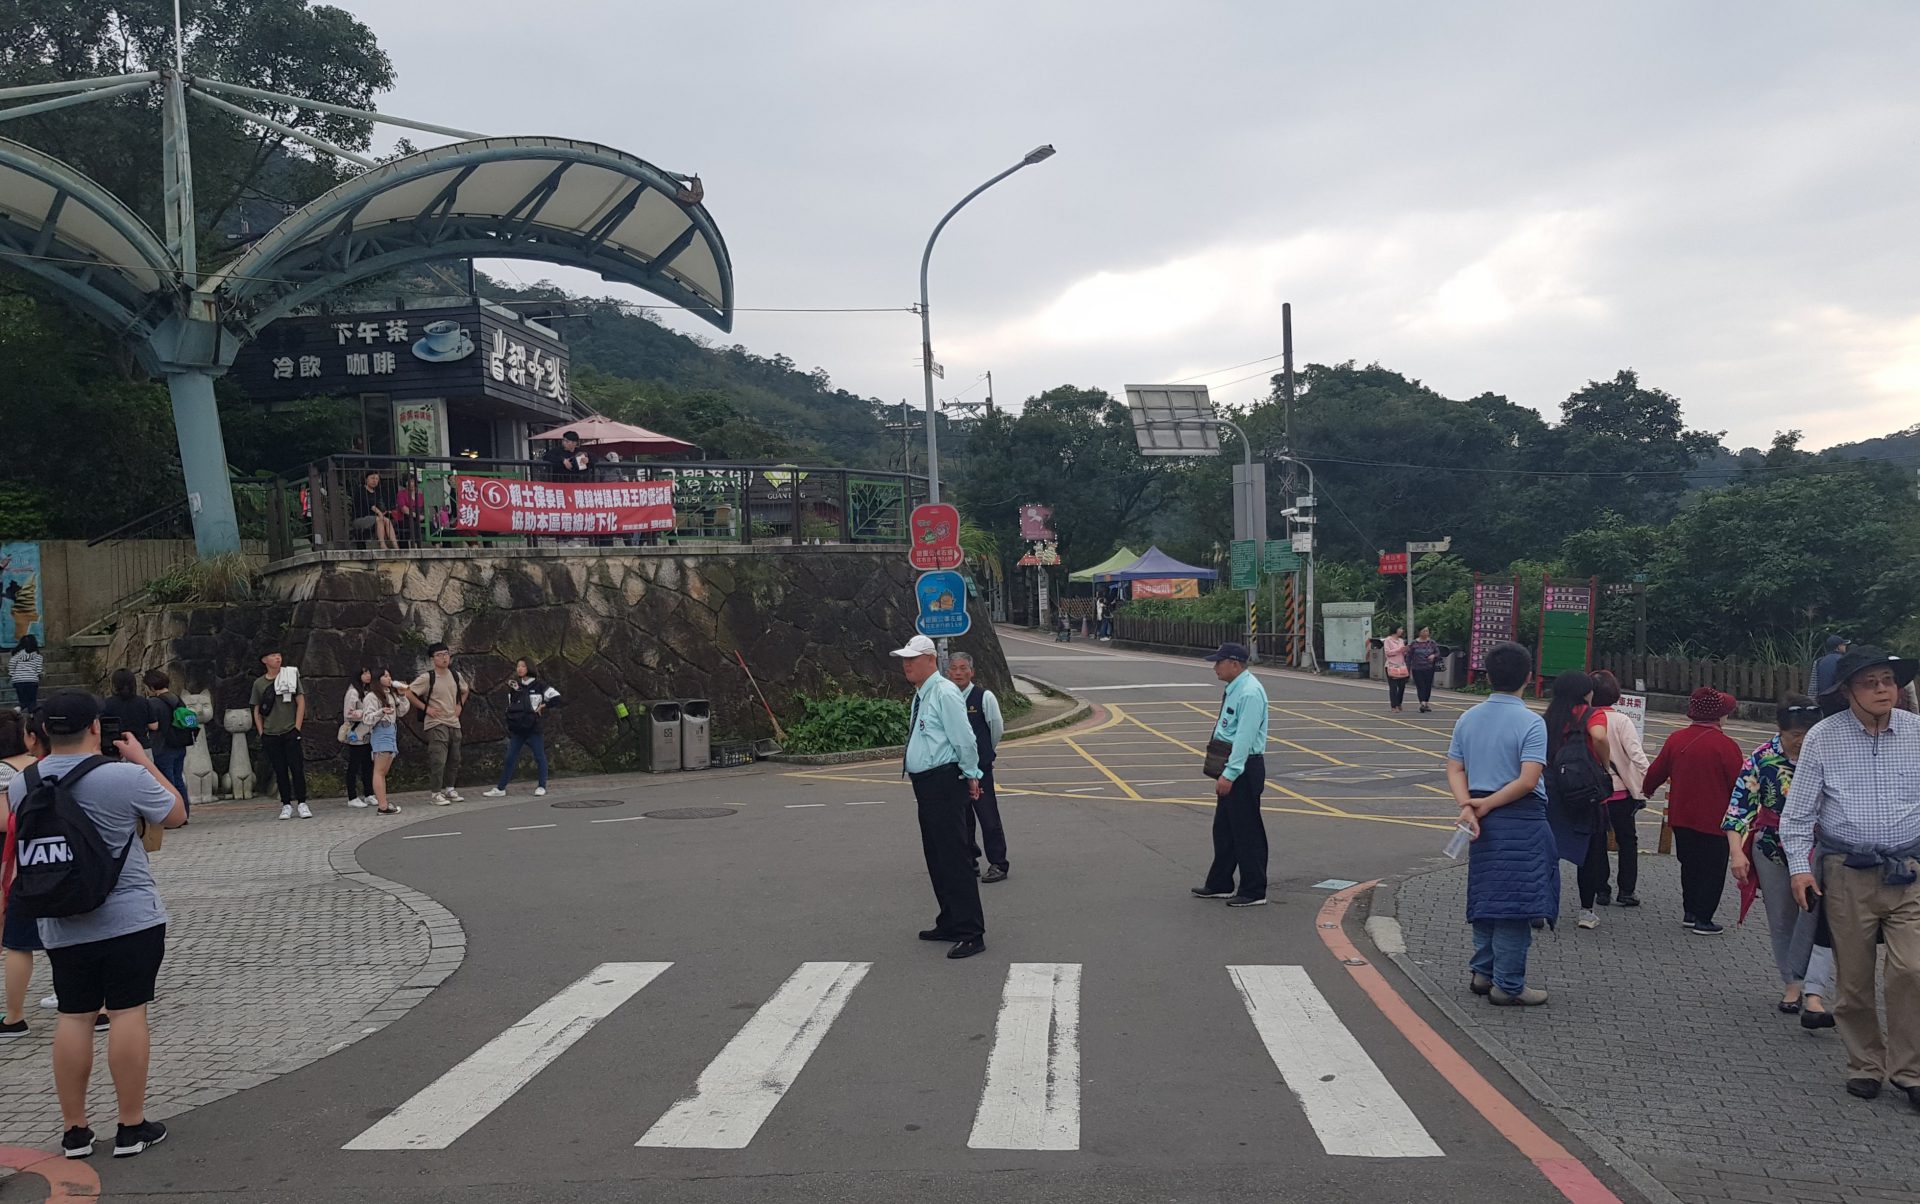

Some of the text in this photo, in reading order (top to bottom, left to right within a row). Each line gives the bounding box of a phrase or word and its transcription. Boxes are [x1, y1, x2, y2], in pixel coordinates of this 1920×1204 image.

[337, 319, 408, 345] 下午茶
[272, 351, 396, 379] 冷飲 咖啡
[460, 480, 480, 527] 感謝
[512, 511, 617, 532] 協助本區電線地下化
